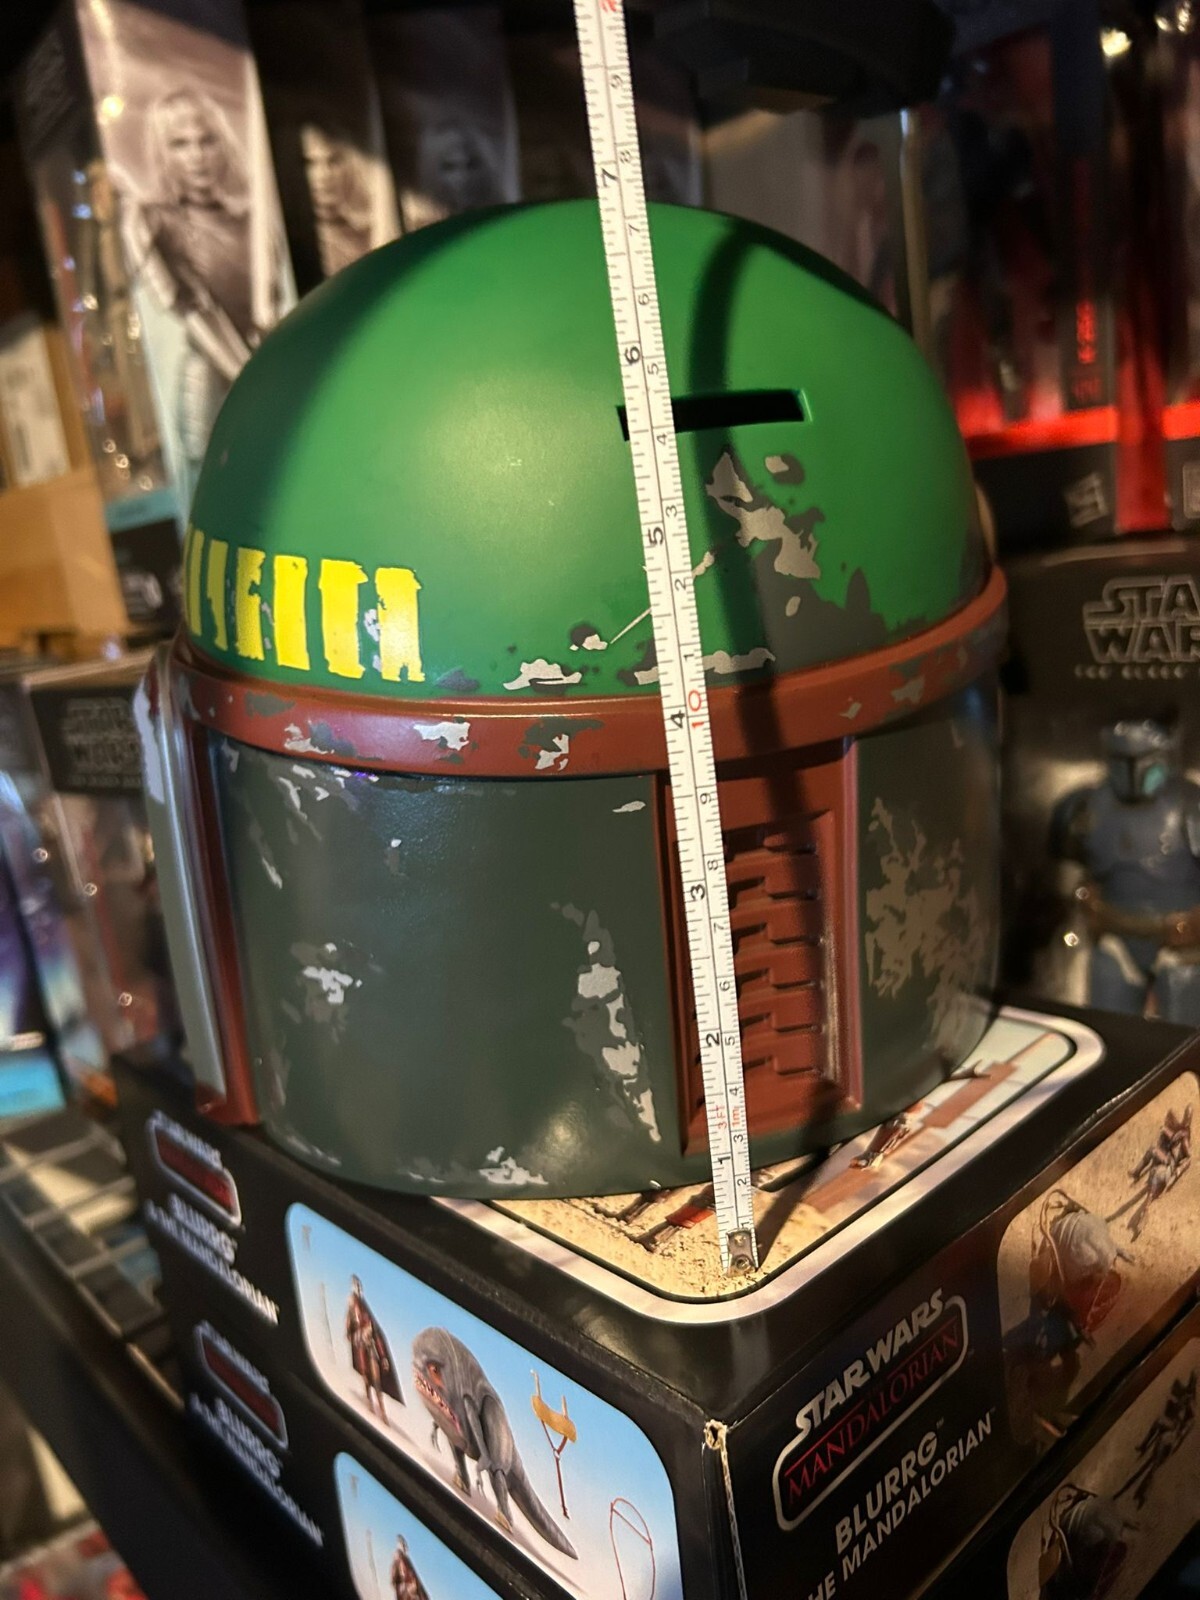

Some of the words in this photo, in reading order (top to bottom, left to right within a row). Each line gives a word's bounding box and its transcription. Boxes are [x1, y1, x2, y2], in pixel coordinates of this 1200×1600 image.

[602, 168, 618, 188] 7
[628, 223, 640, 236] 7
[638, 292, 650, 306] 6
[624, 346, 641, 365] 6
[648, 363, 659, 375] 5
[657, 433, 668, 446] 4
[665, 504, 678, 517] 3
[648, 527, 664, 545] 5
[675, 578, 687, 591] 2
[683, 653, 695, 662] 1
[688, 690, 704, 729] 10
[670, 710, 685, 729] 4
[700, 792, 712, 805] 9
[707, 859, 718, 871] 8
[690, 884, 706, 901] 3
[713, 922, 725, 934] 7
[720, 980, 731, 992] 6
[705, 1032, 721, 1047] 2
[724, 1036, 735, 1046] 5
[729, 1087, 739, 1096] 4
[733, 1134, 744, 1143] 3
[718, 1156, 731, 1165] 1
[737, 1177, 747, 1186] 2
[796, 1359, 871, 1436] STAR
[866, 1288, 943, 1374] WARS
[785, 1322, 959, 1503] MANDALORIAN
[835, 1431, 938, 1555] BLURRG
[842, 1411, 992, 1582] MANDALORIAN
